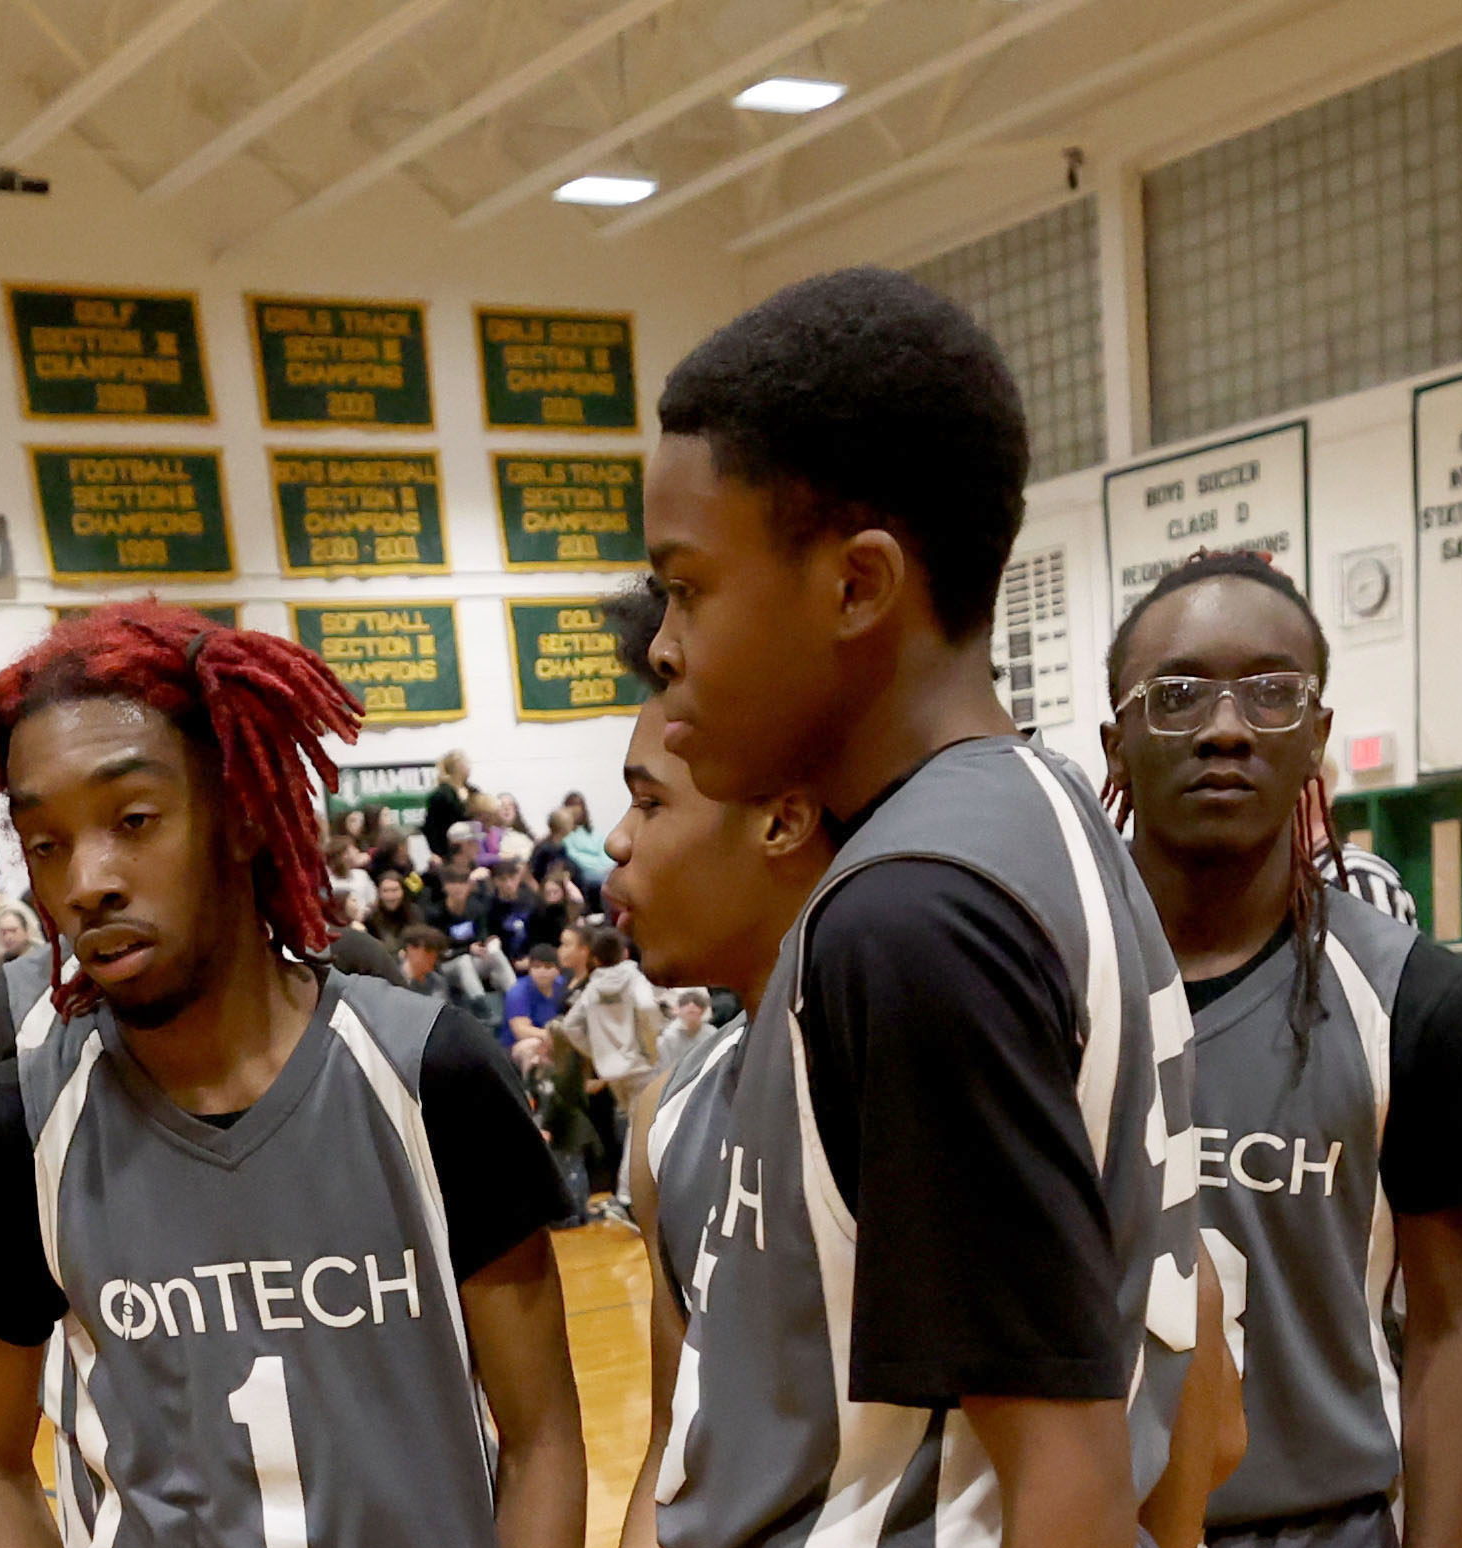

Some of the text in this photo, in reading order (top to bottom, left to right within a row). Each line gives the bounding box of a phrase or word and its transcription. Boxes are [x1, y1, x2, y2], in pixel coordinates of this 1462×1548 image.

[571, 461, 633, 484] TRACK
[71, 510, 205, 537] CHAMPIONS
[303, 510, 422, 535] CHAMPIONS
[522, 510, 629, 534] CHAMPIONS
[320, 610, 432, 635] SOFTBALL
[320, 634, 411, 660] SECTION
[537, 632, 618, 656] SECTION
[1194, 1126, 1343, 1197] ECH
